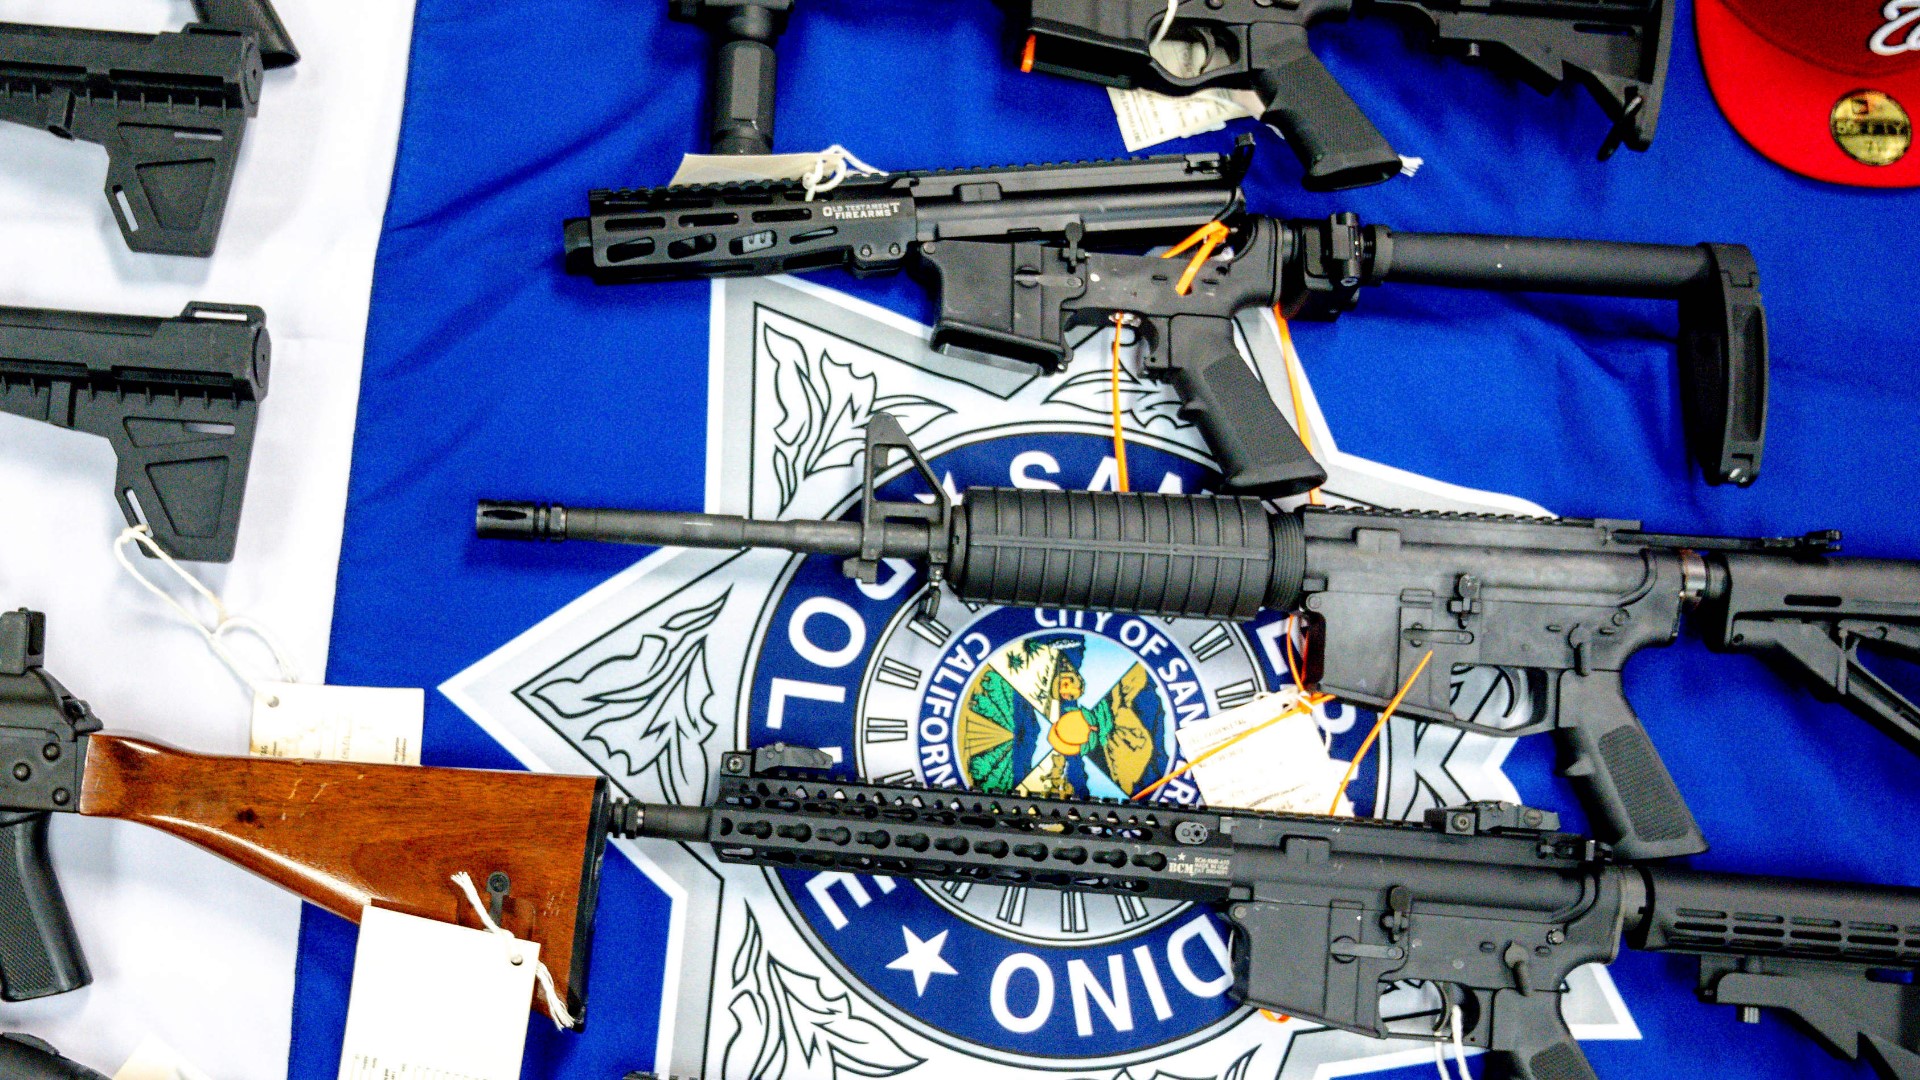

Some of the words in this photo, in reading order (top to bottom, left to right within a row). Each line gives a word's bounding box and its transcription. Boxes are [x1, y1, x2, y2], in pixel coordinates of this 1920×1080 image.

[822, 205, 843, 217] OLD
[845, 202, 900, 213] TESTAMENT
[835, 209, 892, 220] FIREARMS
[1120, 619, 1169, 658] OF
[1157, 659, 1210, 729] SAN
[919, 632, 991, 788] CALIFORN
[1169, 862, 1194, 874] BCM
